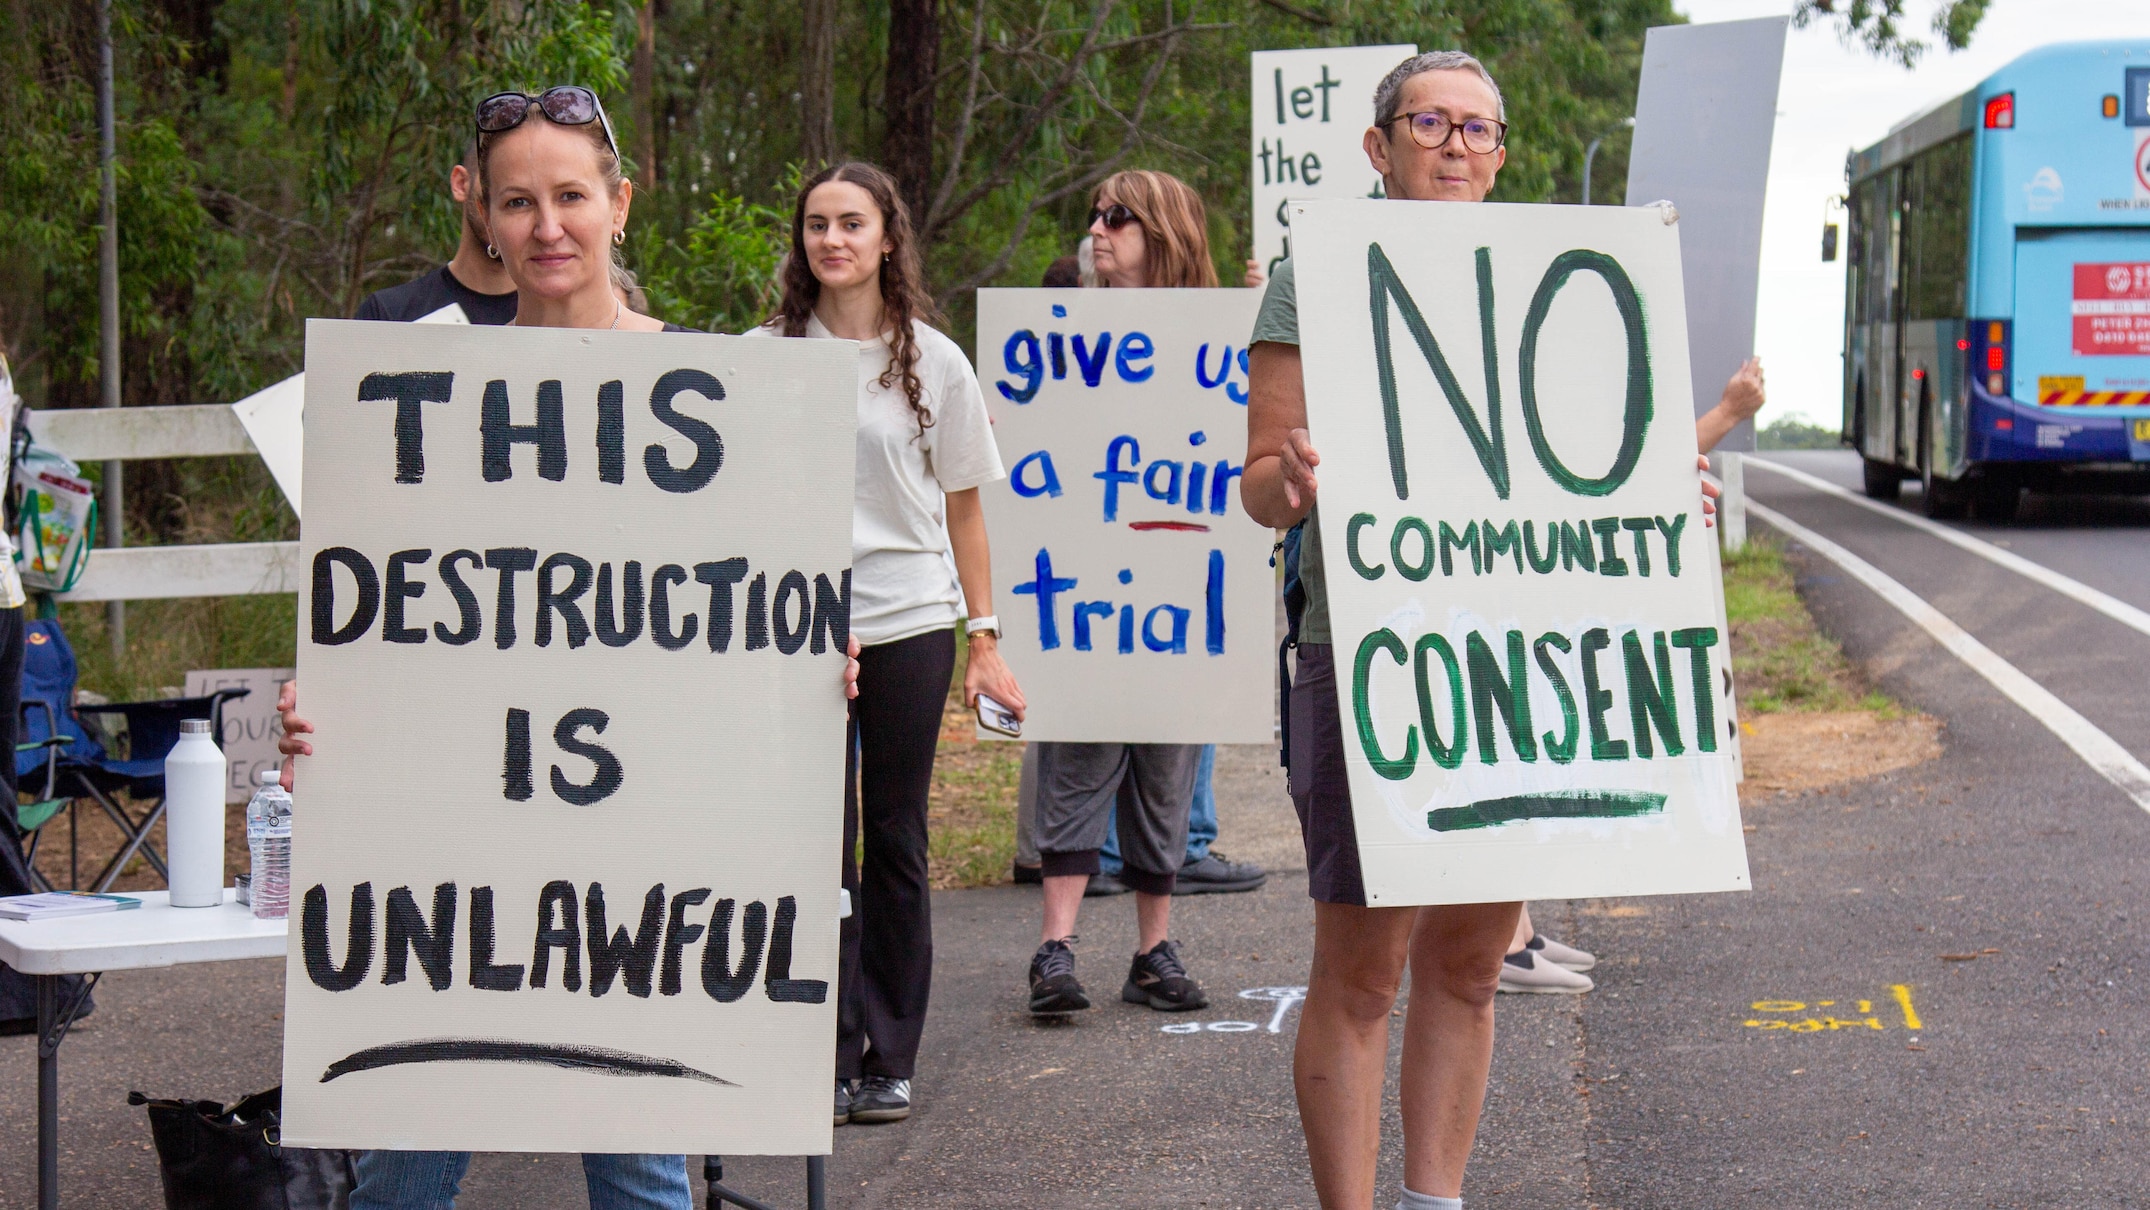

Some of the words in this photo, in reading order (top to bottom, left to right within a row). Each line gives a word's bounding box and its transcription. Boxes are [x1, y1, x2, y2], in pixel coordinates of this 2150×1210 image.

[1275, 65, 1341, 124] let
[1258, 137, 1322, 185] the
[996, 304, 1154, 404] give
[1195, 343, 1249, 405] us
[1368, 242, 1653, 500] NO
[2091, 317, 2132, 329] PETER
[358, 368, 726, 493] THIS
[1010, 450, 1063, 498] a
[1093, 430, 1242, 522] fair
[1346, 513, 1687, 581] COMMUNITY
[312, 546, 851, 656] DESTRUCTION
[1012, 547, 1225, 656] trial
[1352, 627, 1718, 780] CONSENT
[501, 708, 624, 806] IS
[300, 880, 828, 1004] UNLAWFUL
